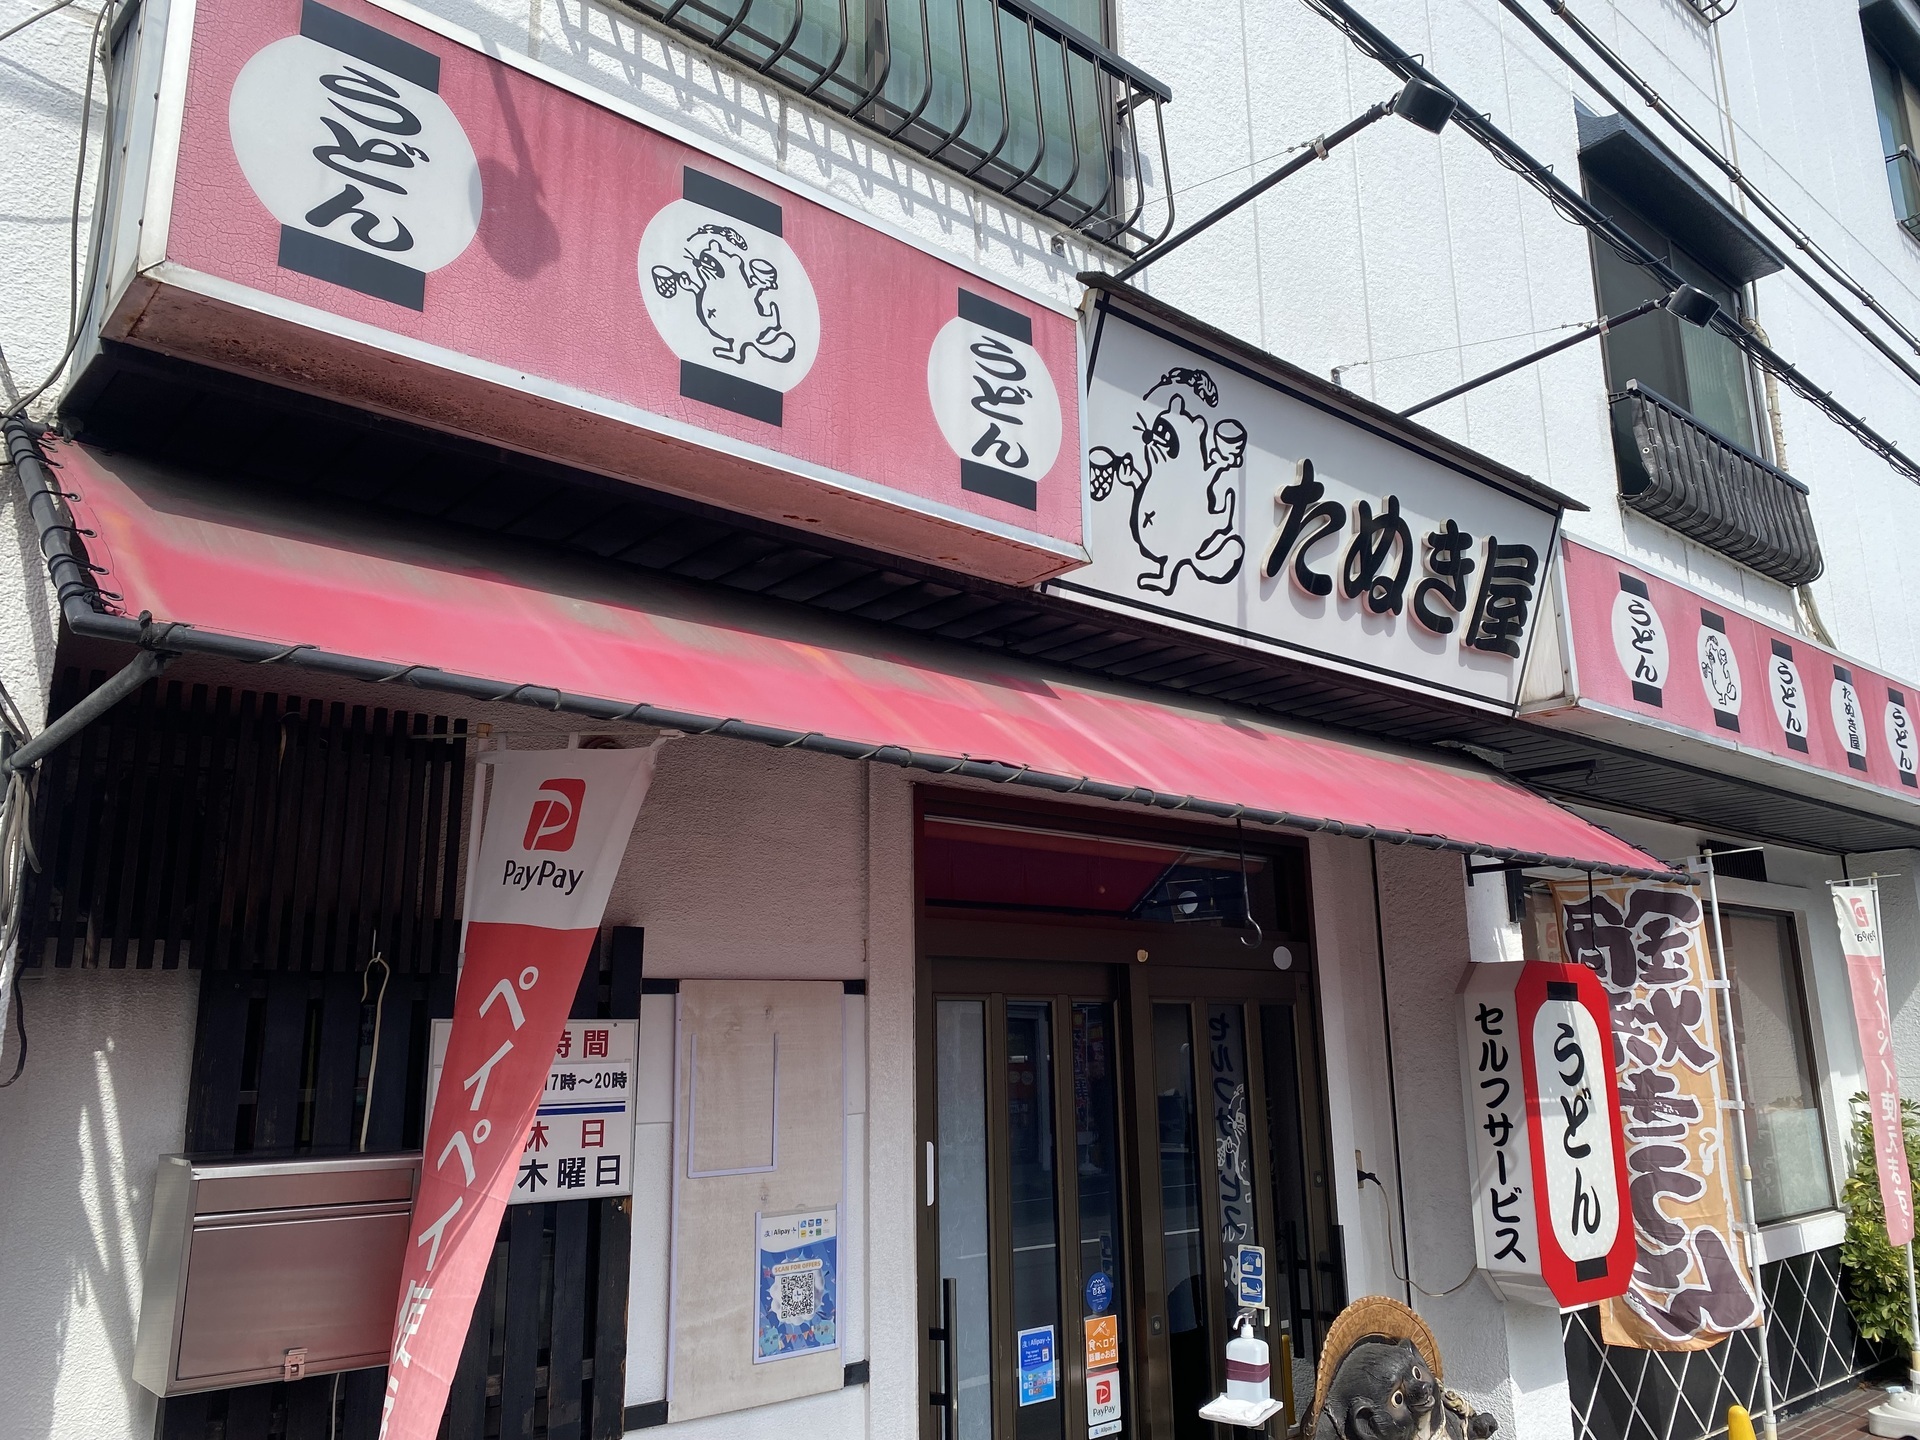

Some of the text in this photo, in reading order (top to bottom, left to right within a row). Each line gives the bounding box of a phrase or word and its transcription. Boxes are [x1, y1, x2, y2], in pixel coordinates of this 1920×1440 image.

[304, 65, 430, 253] うどん
[969, 333, 1032, 469] うどん
[1261, 458, 1538, 659] たぬき屋
[1628, 599, 1658, 683] うどん
[1777, 661, 1802, 733] うどん
[1842, 685, 1861, 751] たぬき屋
[1892, 707, 1913, 770] うどん
[502, 859, 585, 896] PayPay
[1474, 1002, 1527, 1264] セルフサービス
[1553, 1022, 1601, 1236] うどん
[517, 1155, 621, 1193] 木曜日
[774, 1265, 790, 1273] SCAN
[802, 1260, 821, 1269] OFFERS
[1088, 1335, 1116, 1352] 食べログ
[1092, 1405, 1116, 1417] PayPay
